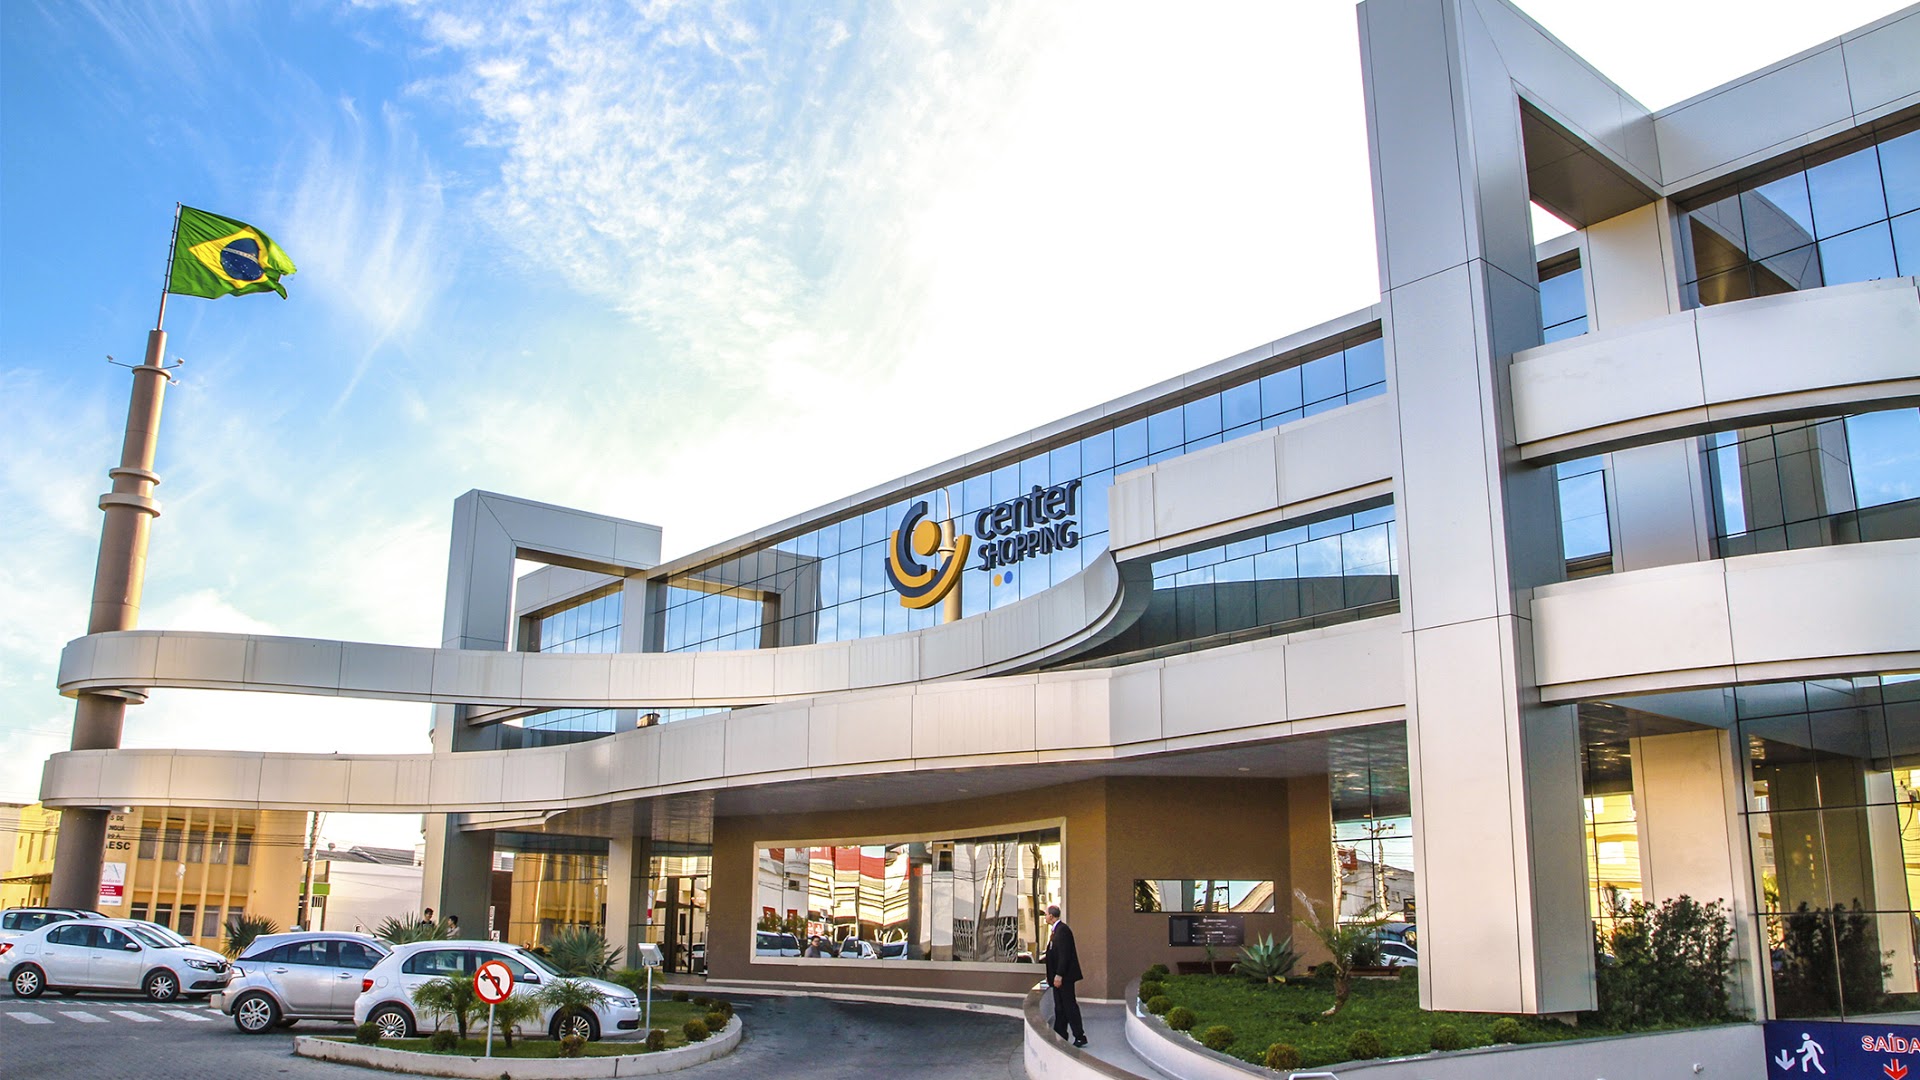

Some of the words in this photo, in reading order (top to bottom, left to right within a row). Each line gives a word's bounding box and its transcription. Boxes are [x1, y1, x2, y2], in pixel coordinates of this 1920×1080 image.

[975, 479, 1081, 540] center
[978, 520, 1078, 571] SHOPPING
[1861, 1033, 1920, 1054] SAÍDA
